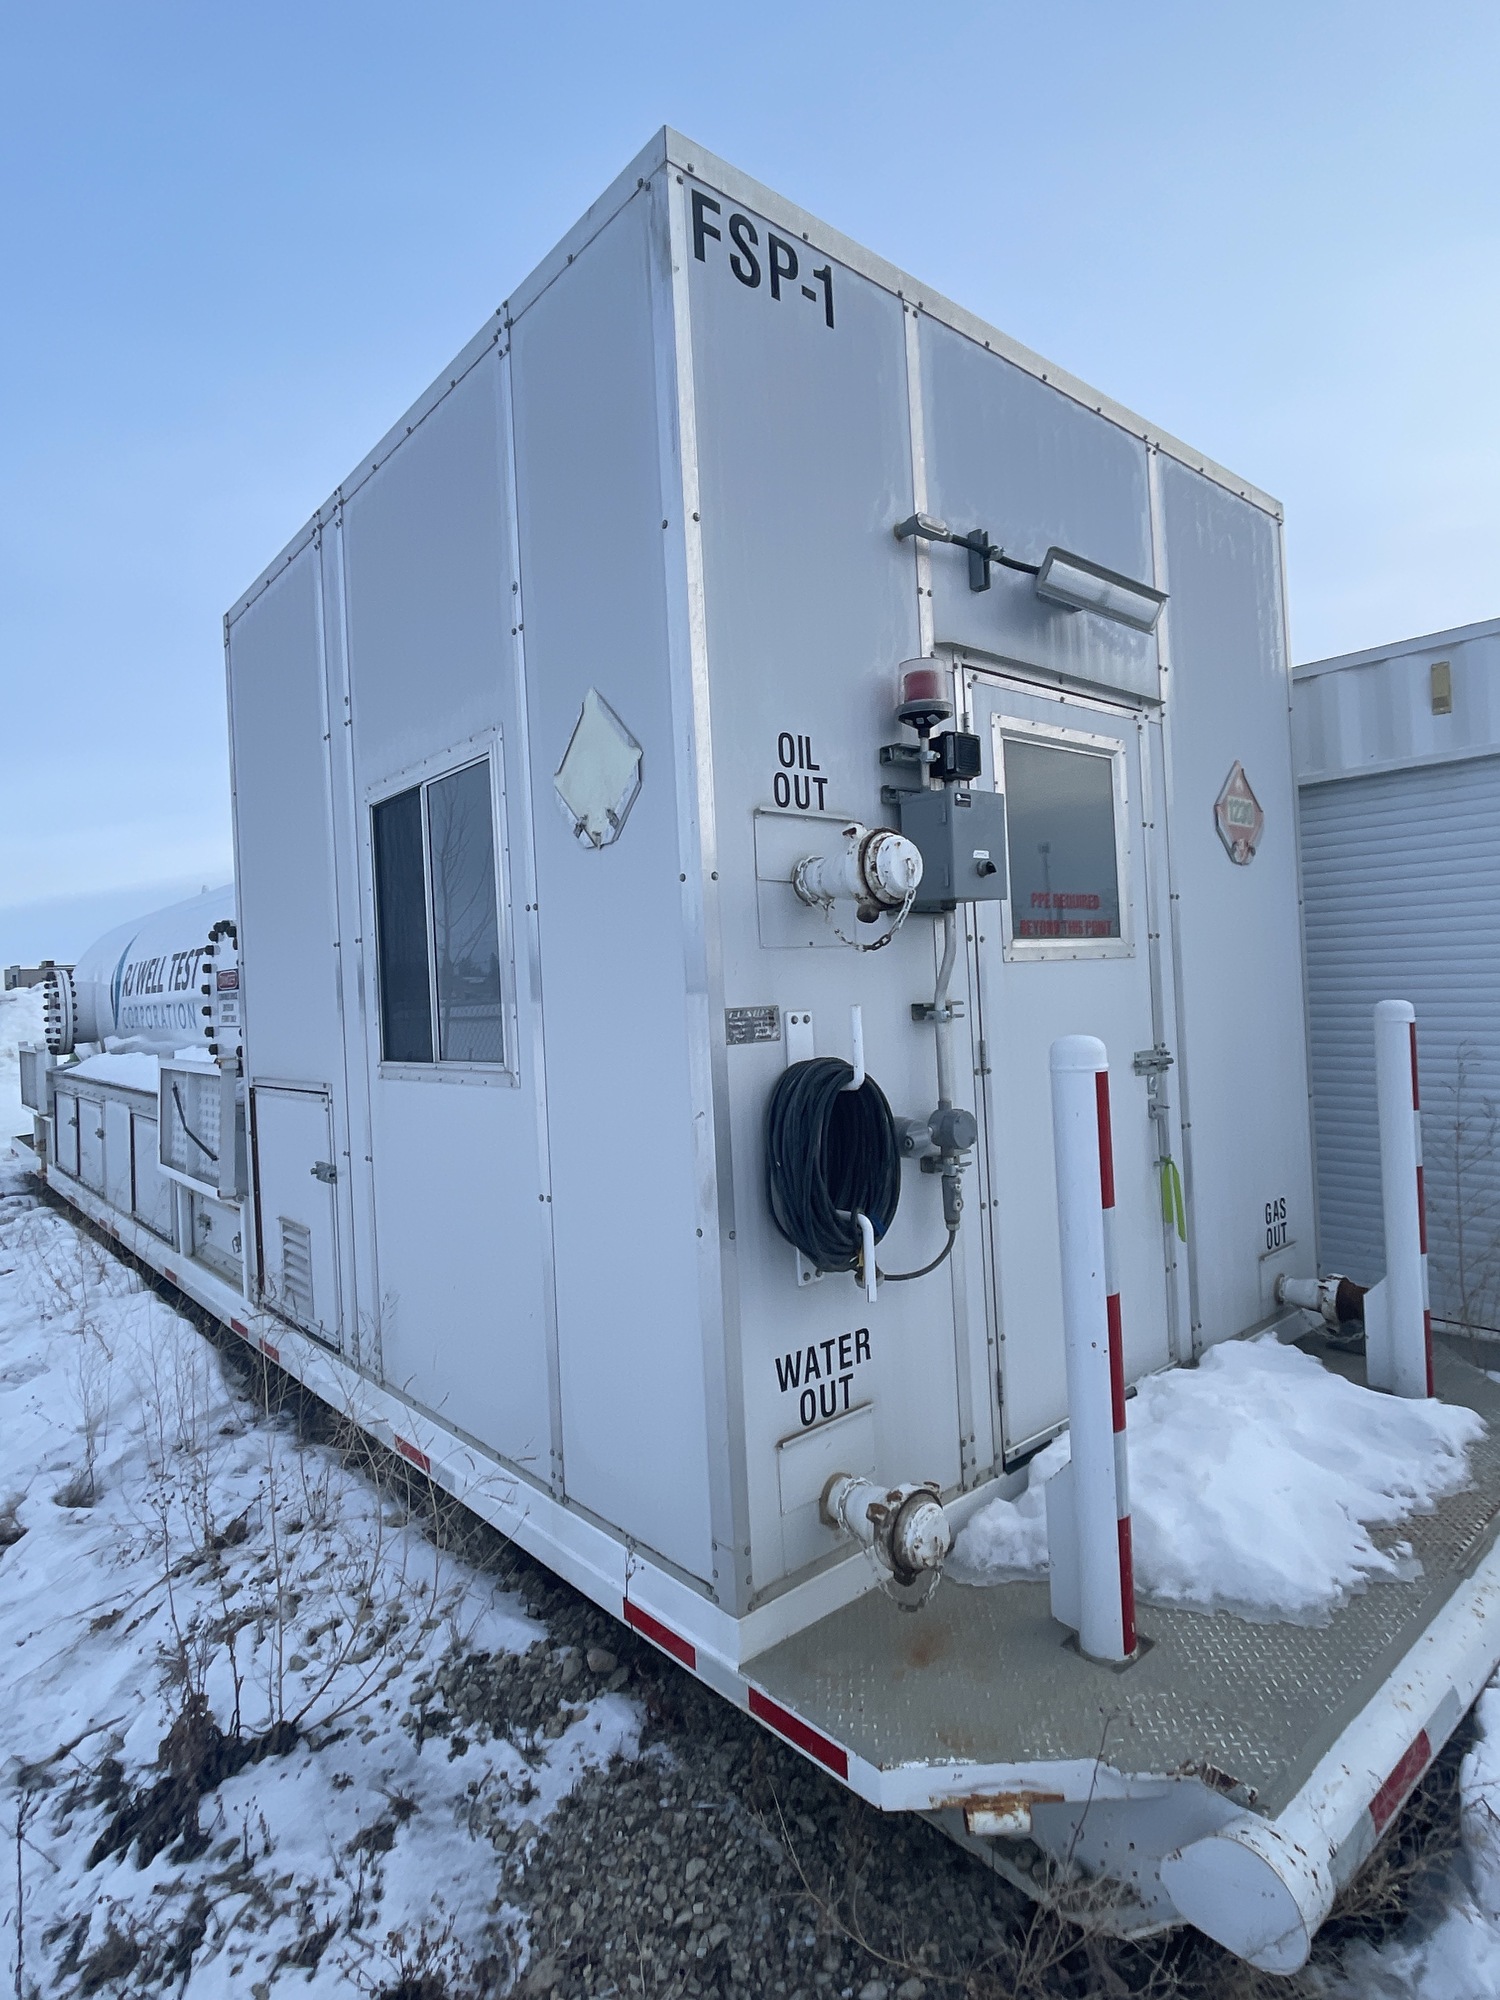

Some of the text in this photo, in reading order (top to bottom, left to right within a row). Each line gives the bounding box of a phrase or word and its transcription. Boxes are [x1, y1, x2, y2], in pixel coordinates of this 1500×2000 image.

[691, 188, 834, 329] FSP-1
[778, 732, 820, 771] OIL
[774, 772, 828, 811] OUT
[1031, 892, 1100, 910] PPE REQUIRED
[136, 955, 167, 995] WELL
[168, 947, 206, 992] TEST
[122, 1003, 197, 1030] CORPORATION
[1265, 1197, 1286, 1225] GAS
[1266, 1222, 1287, 1250] OUT
[775, 1328, 871, 1393] WATER
[800, 1373, 854, 1427] OUT
